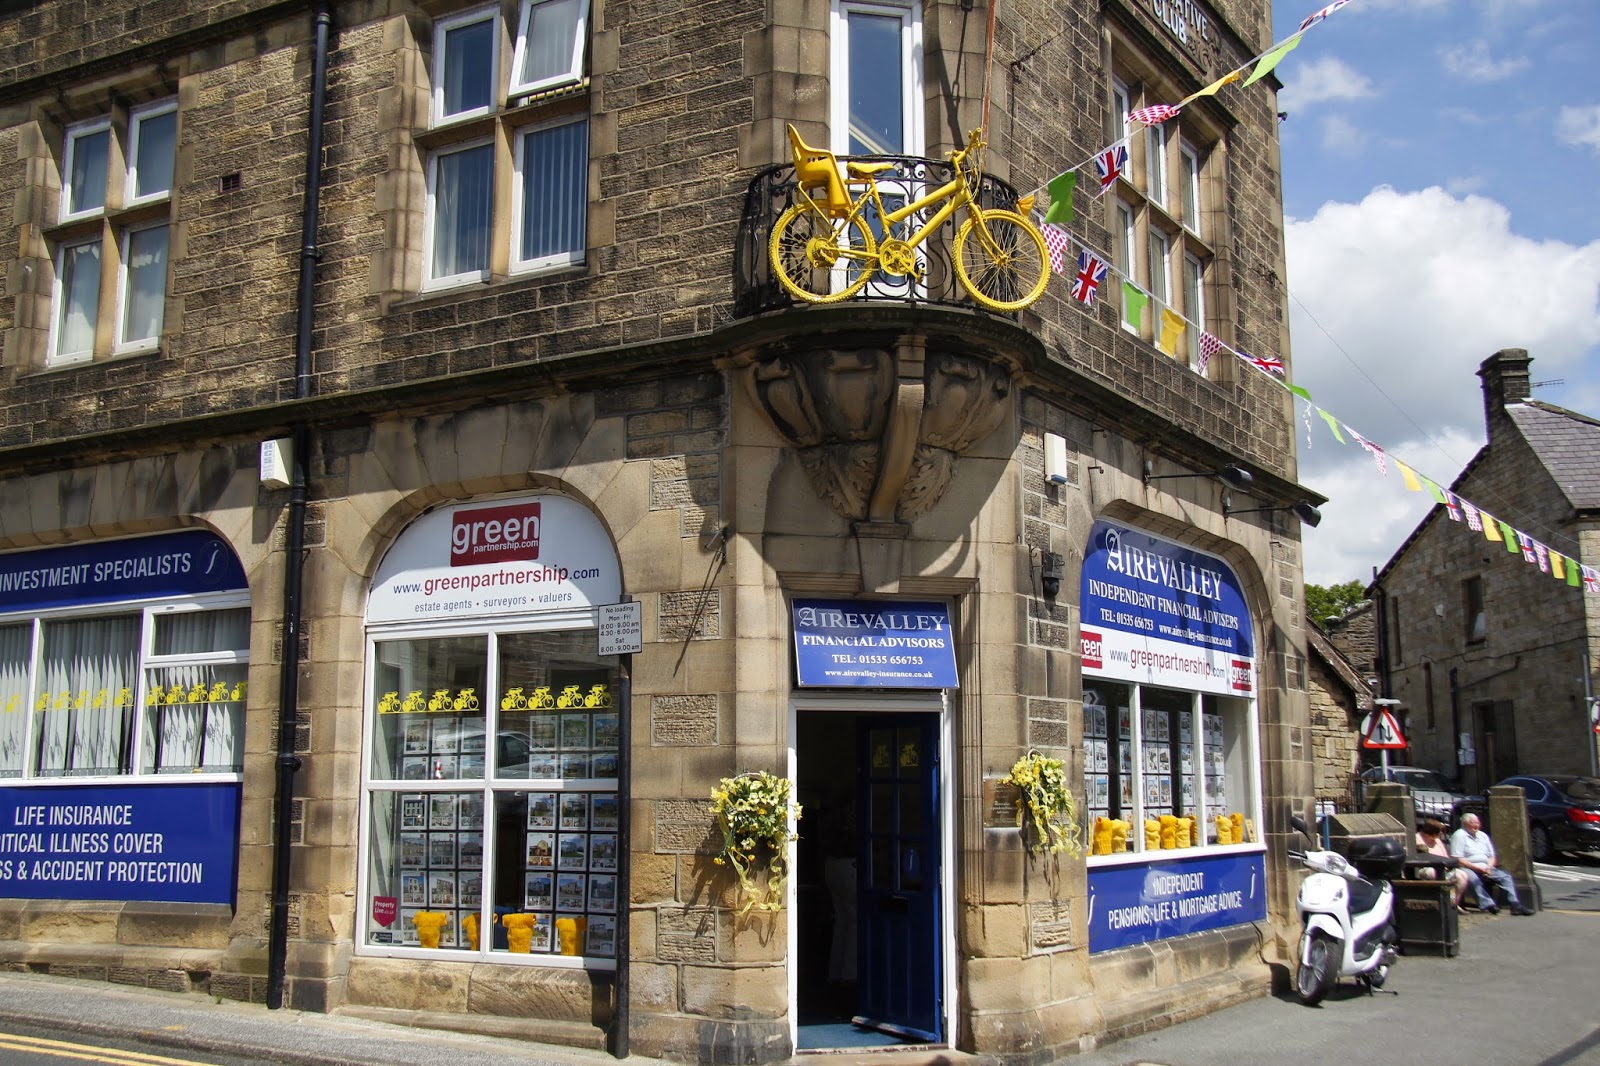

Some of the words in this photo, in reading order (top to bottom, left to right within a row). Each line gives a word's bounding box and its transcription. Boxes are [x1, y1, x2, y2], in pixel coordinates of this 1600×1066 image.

[1153, 0, 1186, 45] CLUB
[1171, 0, 1208, 40] ATIVE
[453, 516, 539, 554] green
[474, 540, 538, 555] partnership.com
[0, 564, 90, 592] INVESTMENT
[94, 552, 191, 582] SPECIALISTS
[1106, 528, 1222, 601] AIREVALLEY
[393, 564, 599, 596] www.greenpartnership.com
[415, 601, 440, 613] estate
[444, 600, 472, 612] agents
[484, 596, 526, 608] surveyors
[539, 592, 572, 603] valuers
[1089, 578, 1156, 610] INDEPENDENT
[1158, 597, 1201, 621] FINANCIAL
[1203, 609, 1238, 630] ADVISERS
[798, 607, 945, 631] AIREVALLEY
[1100, 608, 1115, 622] TEL:
[1117, 612, 1134, 626] 01535
[1135, 616, 1154, 630] 656753
[802, 635, 877, 647] FINANCIAL
[880, 637, 945, 648] ADVISORS
[832, 654, 856, 663] TEL:
[859, 655, 887, 664] 01535
[890, 656, 923, 665] 656753
[1110, 648, 1225, 680] www.greenpartnership.com
[825, 670, 933, 678] www.airevalley-insurance.co.uk
[15, 806, 45, 826] LIFE
[50, 805, 132, 825] INSURANCE
[0, 833, 45, 852] ITICAL
[50, 833, 108, 853] ILLNESS
[114, 833, 163, 853] COVER
[17, 860, 27, 880] &
[31, 860, 104, 881] ACCIDENT
[108, 862, 202, 884] PROTECTION
[1154, 872, 1204, 895] INDEPENDENT
[1154, 902, 1170, 921] LIFE
[1172, 901, 1178, 919] &
[1179, 894, 1218, 917] MORTGAGE
[1219, 890, 1242, 910] ADVICE
